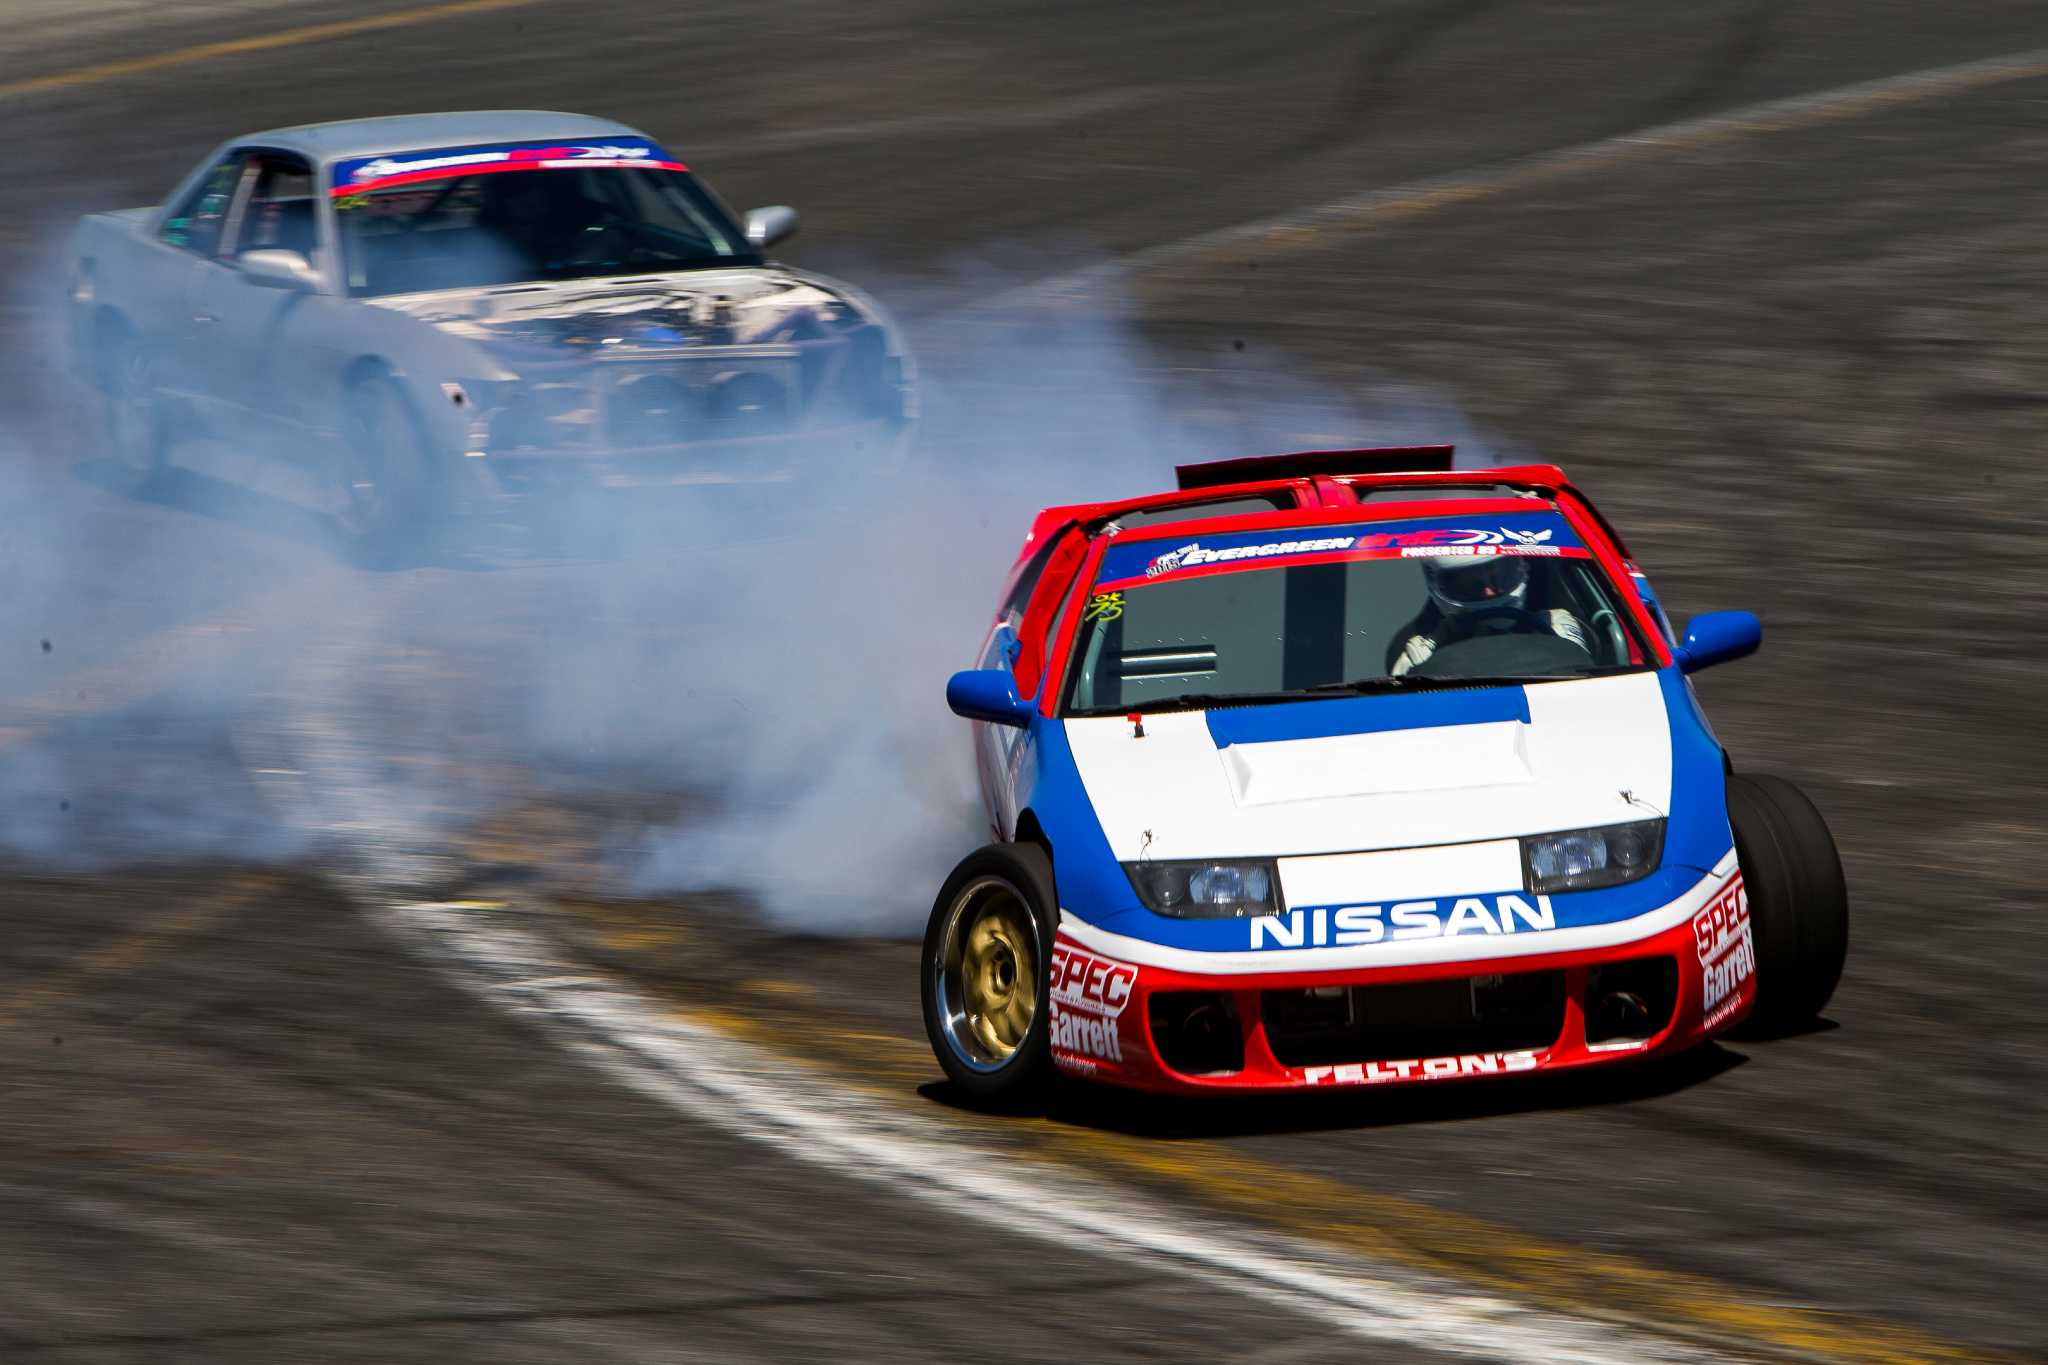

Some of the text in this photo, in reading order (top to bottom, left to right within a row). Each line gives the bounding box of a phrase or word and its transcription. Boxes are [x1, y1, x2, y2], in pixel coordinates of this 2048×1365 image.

[1181, 536, 1355, 566] EVERGREEN
[1250, 894, 1556, 950] NISSAN
[1695, 883, 1750, 957] SPEC
[1050, 950, 1136, 1010] SPEC
[1703, 927, 1756, 1013] Garrett
[1304, 1050, 1537, 1086] FELTON'S
